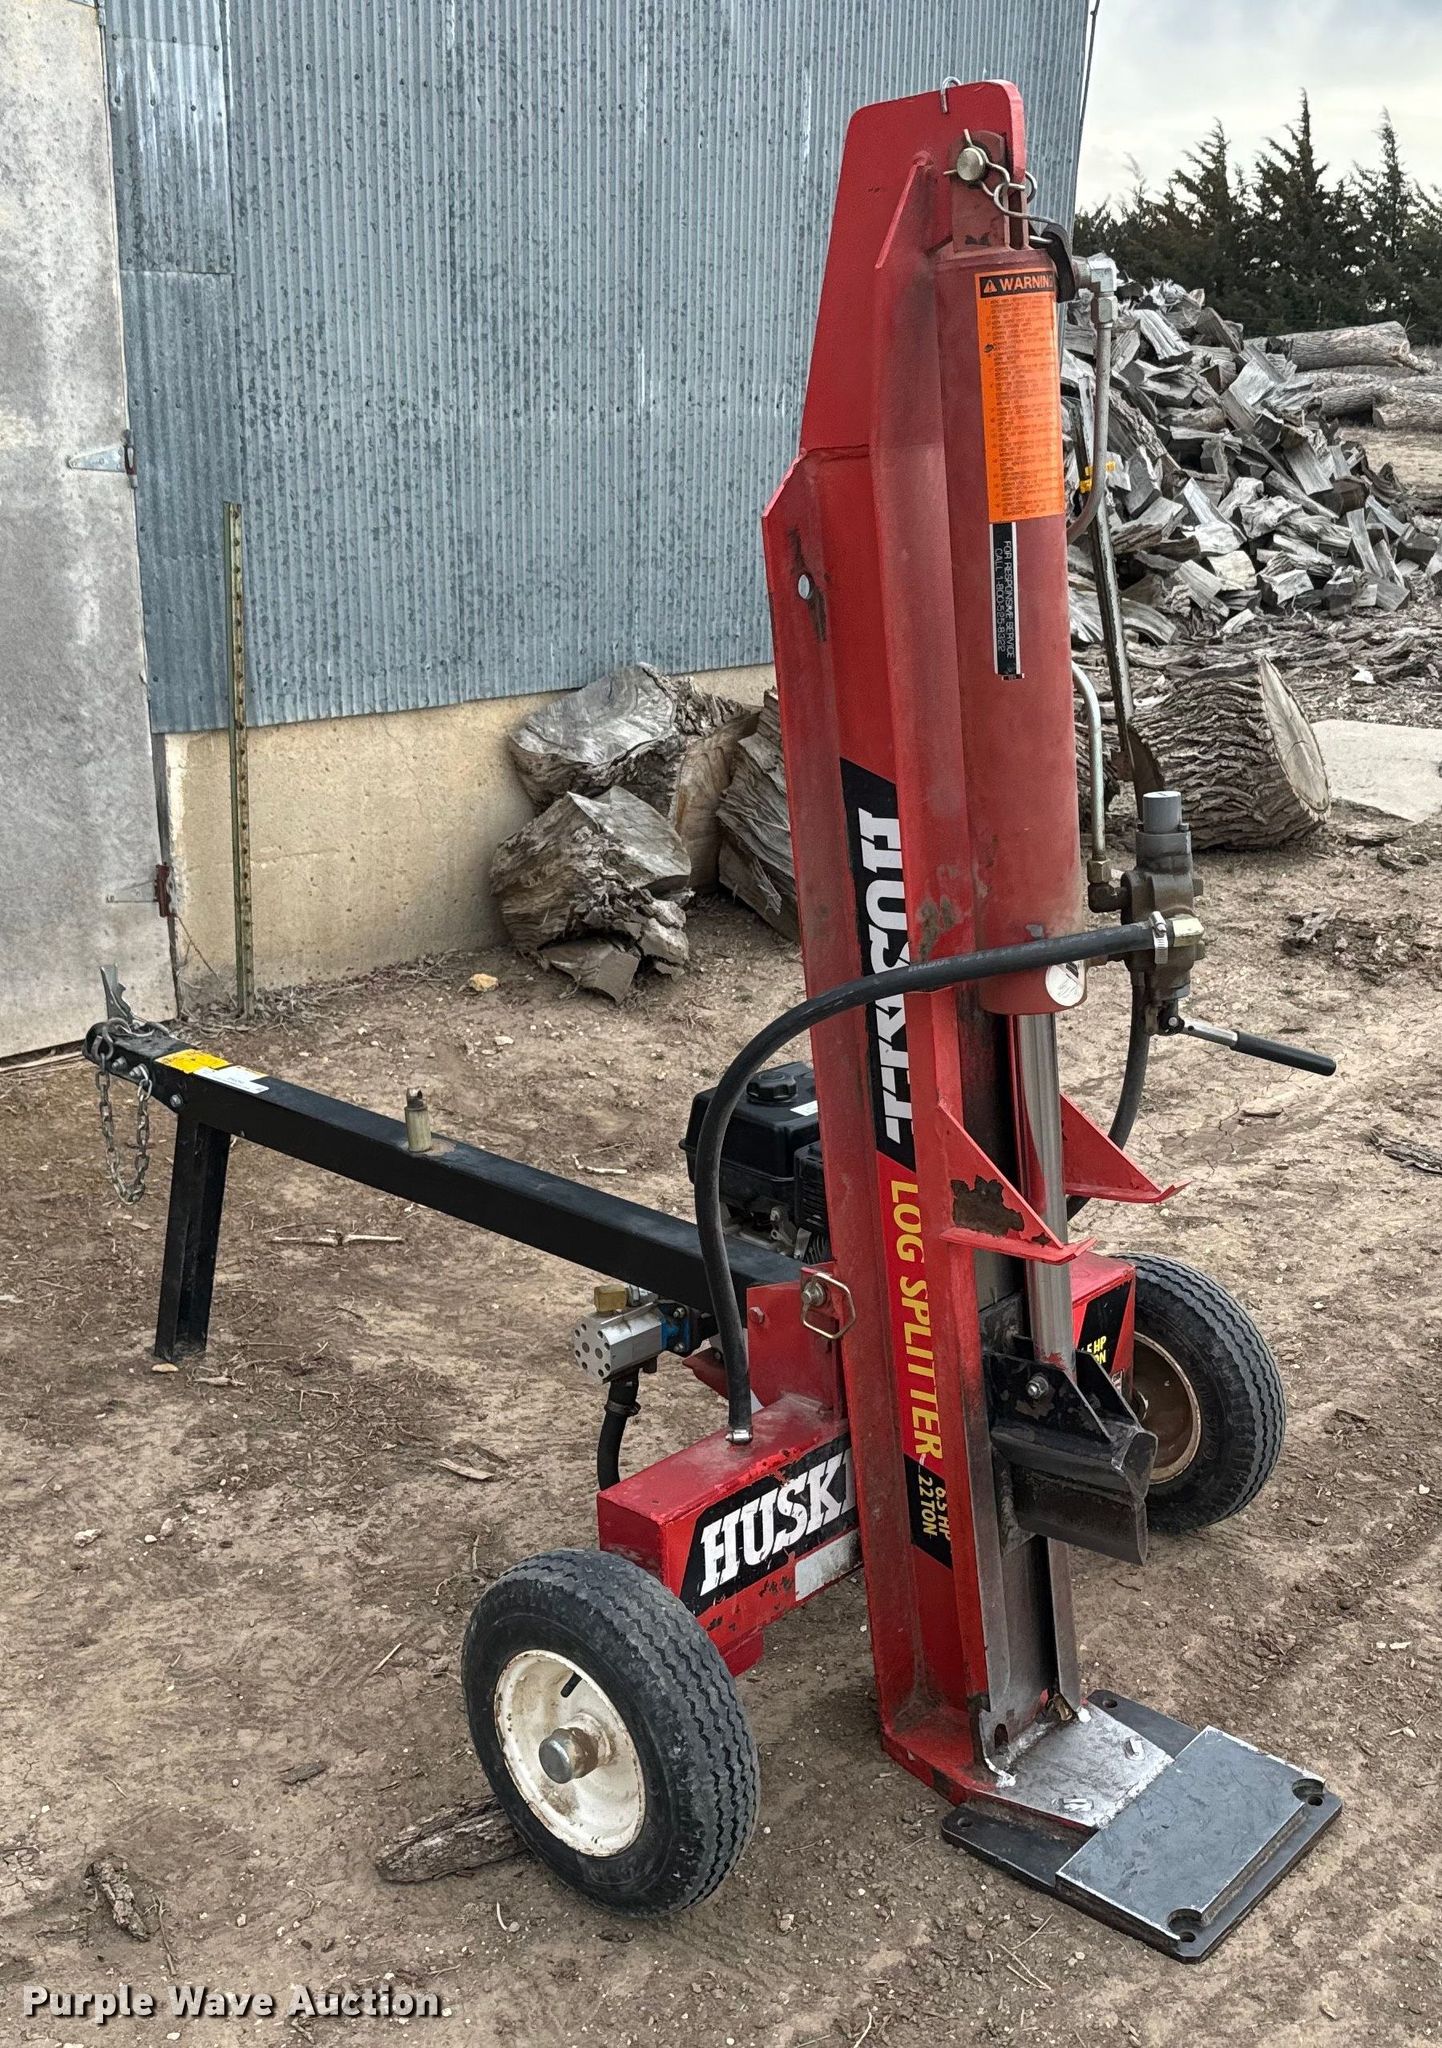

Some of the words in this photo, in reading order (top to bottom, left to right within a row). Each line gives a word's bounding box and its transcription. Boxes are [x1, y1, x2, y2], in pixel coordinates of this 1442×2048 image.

[995, 548, 1003, 572] CALL
[1003, 541, 1012, 559] FOR
[1004, 562, 1014, 620] RESPONSIVE
[1006, 622, 1015, 657] SERVICE
[890, 1180, 925, 1263] LOG
[1093, 1335, 1106, 1351] HP
[900, 1275, 943, 1459] SPLITTER
[918, 1474, 933, 1498] 22
[921, 1500, 938, 1536] TON
[938, 1515, 951, 1541] HP
